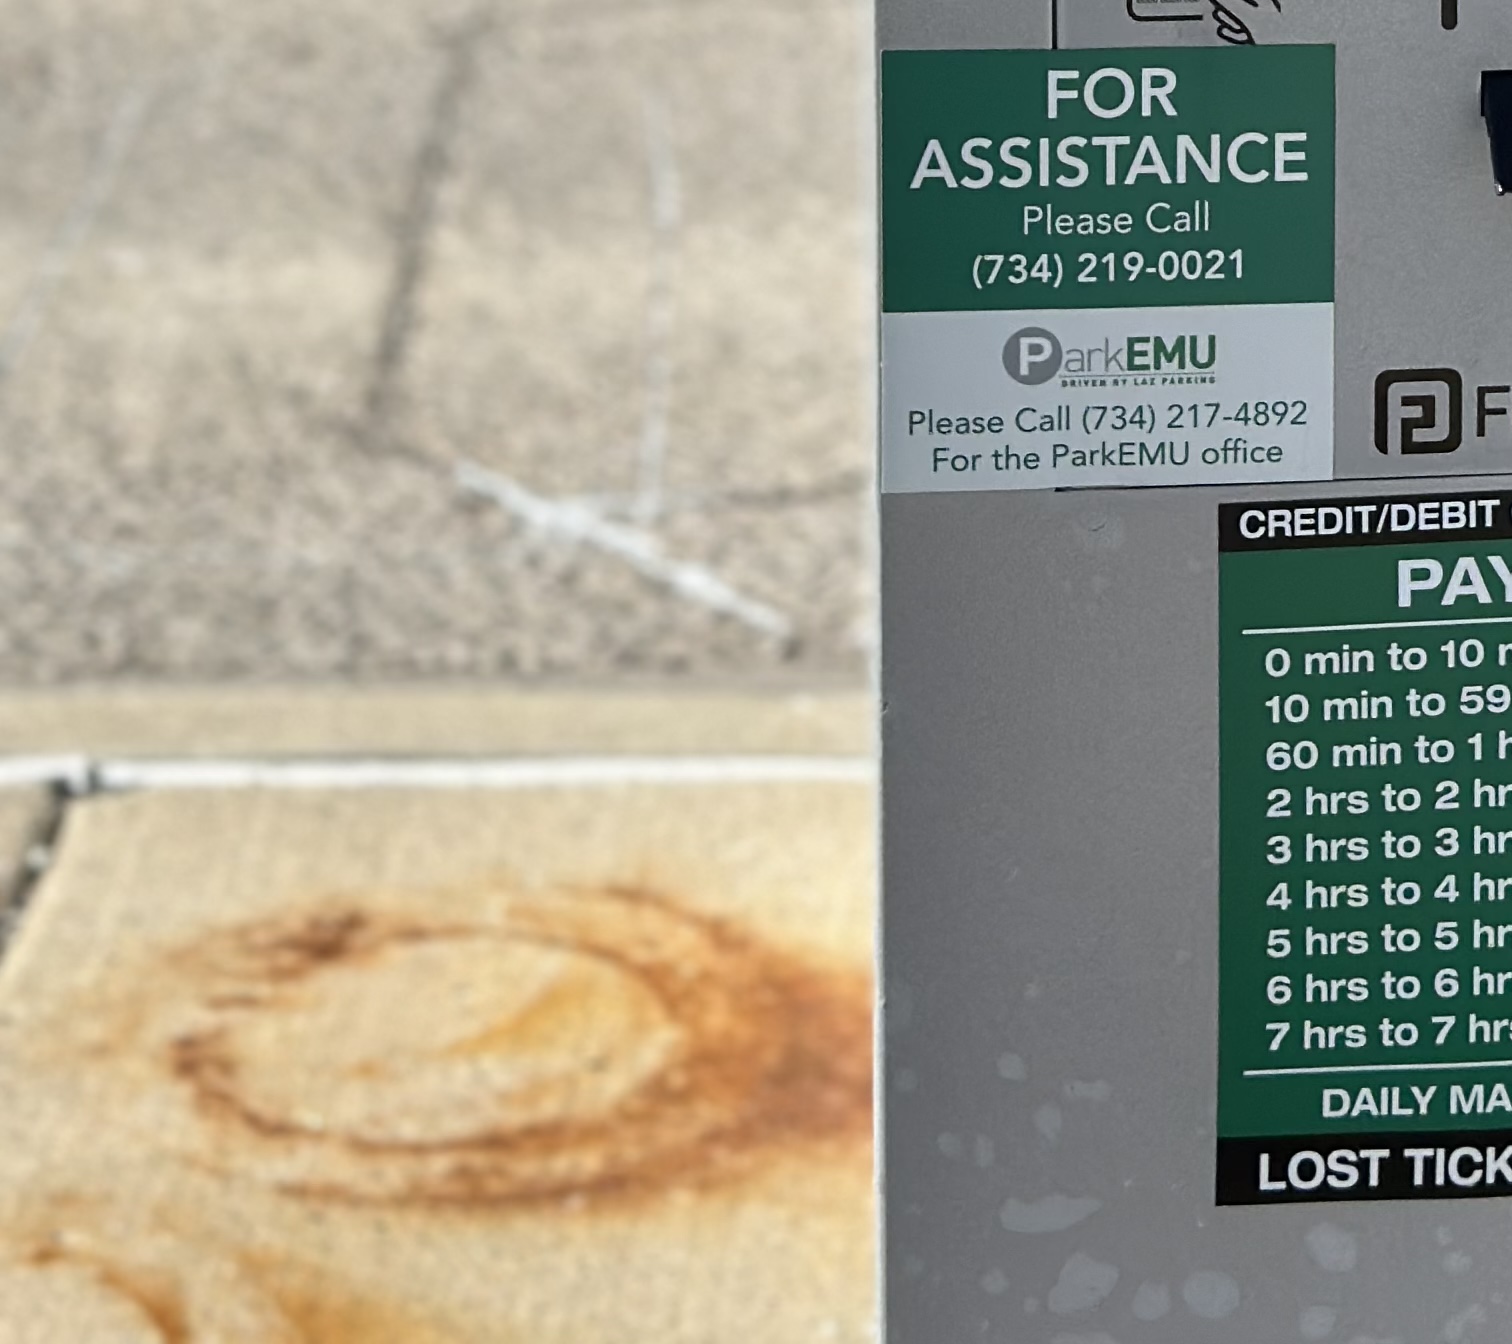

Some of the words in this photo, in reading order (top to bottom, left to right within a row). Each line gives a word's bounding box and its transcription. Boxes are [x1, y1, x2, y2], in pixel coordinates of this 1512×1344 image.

[1048, 68, 1177, 118] FOR
[910, 132, 1308, 188] ASSISTANCE
[1024, 204, 1132, 235] Please
[1146, 200, 1208, 232] Call
[973, 254, 1062, 289] (734)
[1078, 249, 1242, 282] 219-0021
[1018, 335, 1215, 376] ParkEMU
[909, 409, 1003, 435] Please
[1015, 405, 1070, 432] Call
[1083, 405, 1155, 434] (734)
[1167, 401, 1306, 428] 217-4892
[933, 448, 982, 472] For
[992, 445, 1039, 470] the
[1053, 441, 1189, 468] ParkEMU
[1202, 438, 1283, 464] office
[1240, 500, 1500, 538] CREDIT/DEBIT
[1266, 648, 1290, 677] 0
[1305, 644, 1374, 674] min
[1387, 643, 1427, 670] to
[1441, 639, 1484, 667] 10
[1266, 694, 1309, 723] 10
[1324, 690, 1392, 720] min
[1406, 689, 1445, 716] to
[1460, 685, 1510, 714] 59
[1267, 741, 1318, 770] 60
[1333, 737, 1401, 767] min
[1414, 736, 1454, 763] to
[1468, 733, 1481, 760] 1
[1267, 789, 1291, 817] 2
[1306, 787, 1369, 815] hrs
[1382, 784, 1421, 811] to
[1435, 781, 1459, 809] 2
[1267, 836, 1291, 864] 3
[1306, 834, 1368, 862] hrs
[1382, 831, 1420, 858] to
[1435, 828, 1459, 856] 3
[1267, 883, 1291, 910] 4
[1306, 880, 1368, 908] hrs
[1381, 877, 1420, 905] to
[1434, 875, 1459, 902] 4
[1267, 929, 1291, 958] 5
[1306, 927, 1368, 955] hrs
[1381, 924, 1420, 952] to
[1435, 922, 1458, 950] 5
[1267, 976, 1291, 1004] 6
[1306, 974, 1368, 1002] hrs
[1381, 971, 1420, 999] to
[1435, 968, 1459, 997] 6
[1266, 1023, 1290, 1050] 7
[1304, 1020, 1366, 1049] hrs
[1379, 1018, 1418, 1046] to
[1432, 1016, 1455, 1044] 7
[1323, 1086, 1436, 1117] DAILY
[1260, 1149, 1390, 1190] LOST
